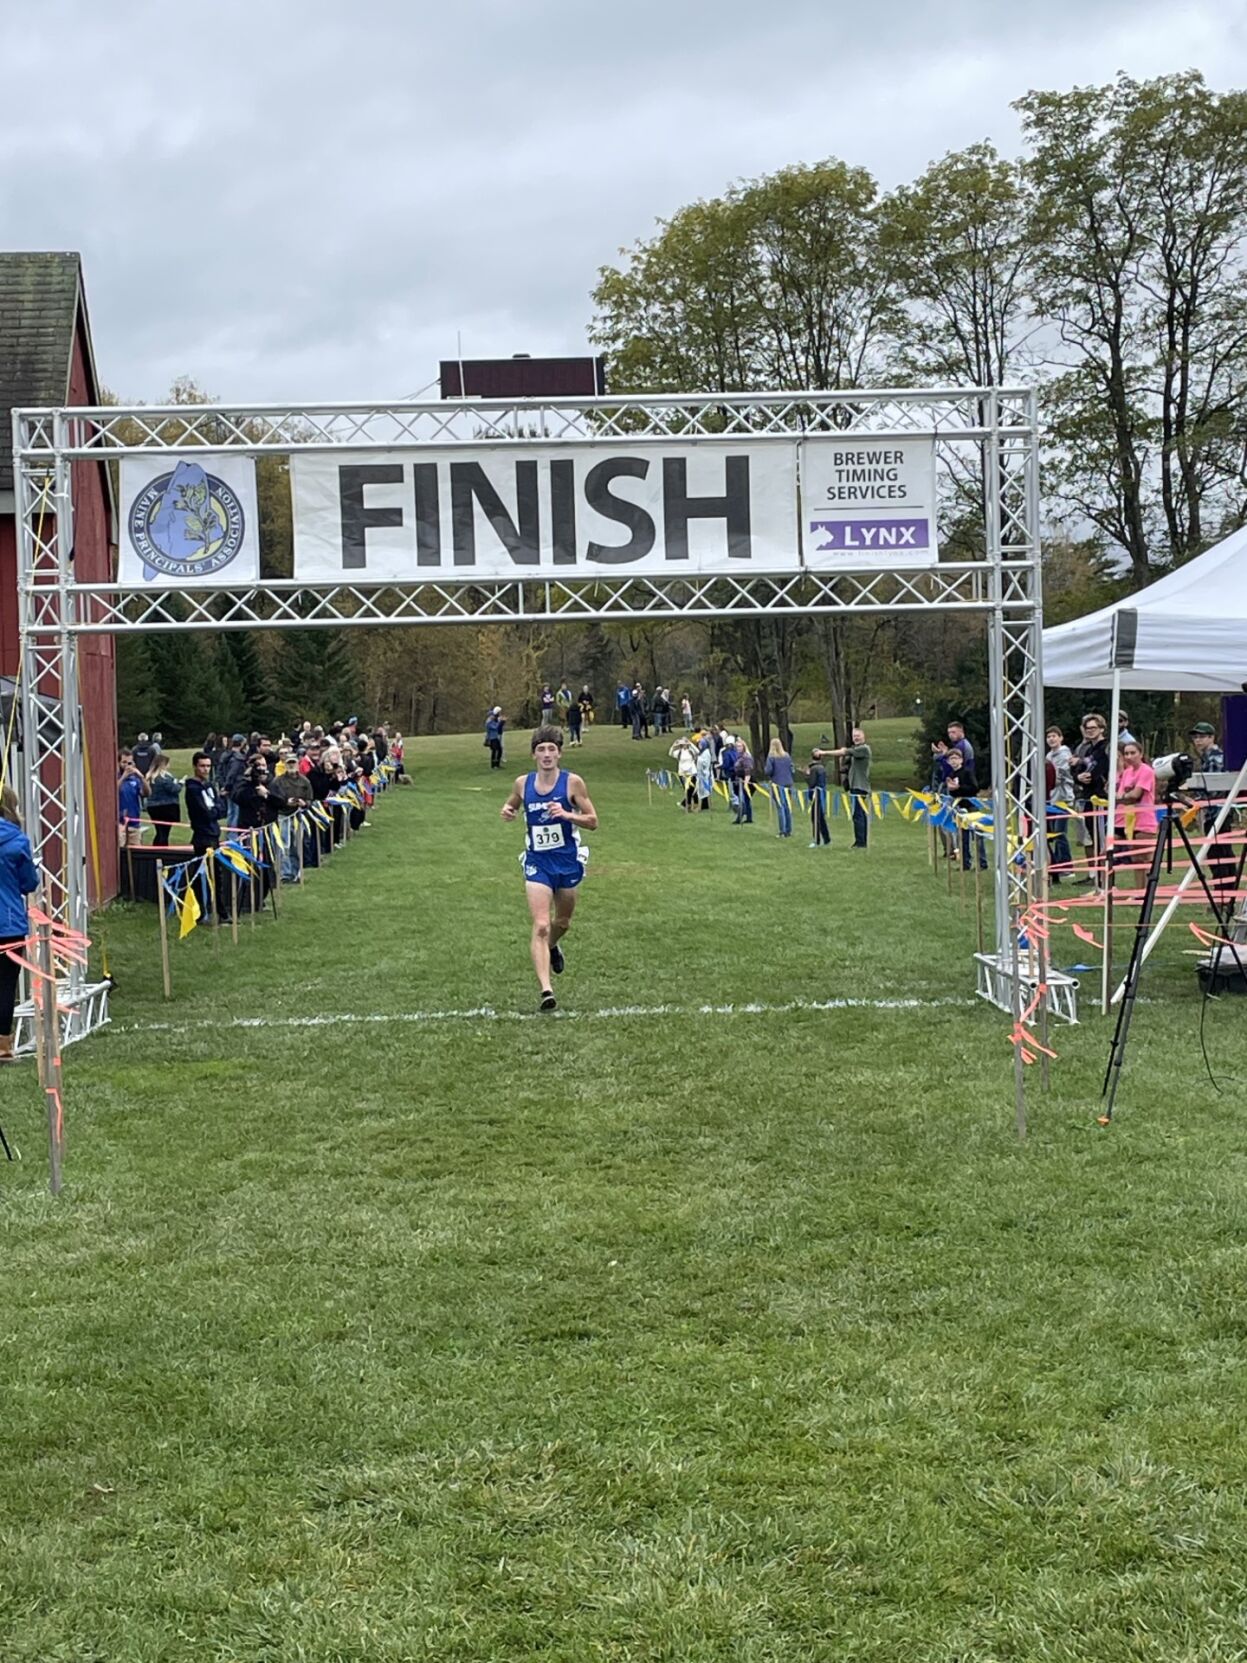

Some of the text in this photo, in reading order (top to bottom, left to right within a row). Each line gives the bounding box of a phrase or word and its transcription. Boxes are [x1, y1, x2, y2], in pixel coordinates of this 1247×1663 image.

[833, 450, 904, 466] BREWER
[835, 468, 898, 483] TIMING
[826, 484, 907, 501] SERVICES
[338, 456, 752, 570] FINISH
[134, 486, 159, 528] MAINE
[211, 486, 240, 568] ASSOCIATION
[844, 526, 916, 546] LYNX
[536, 832, 560, 845] 379
